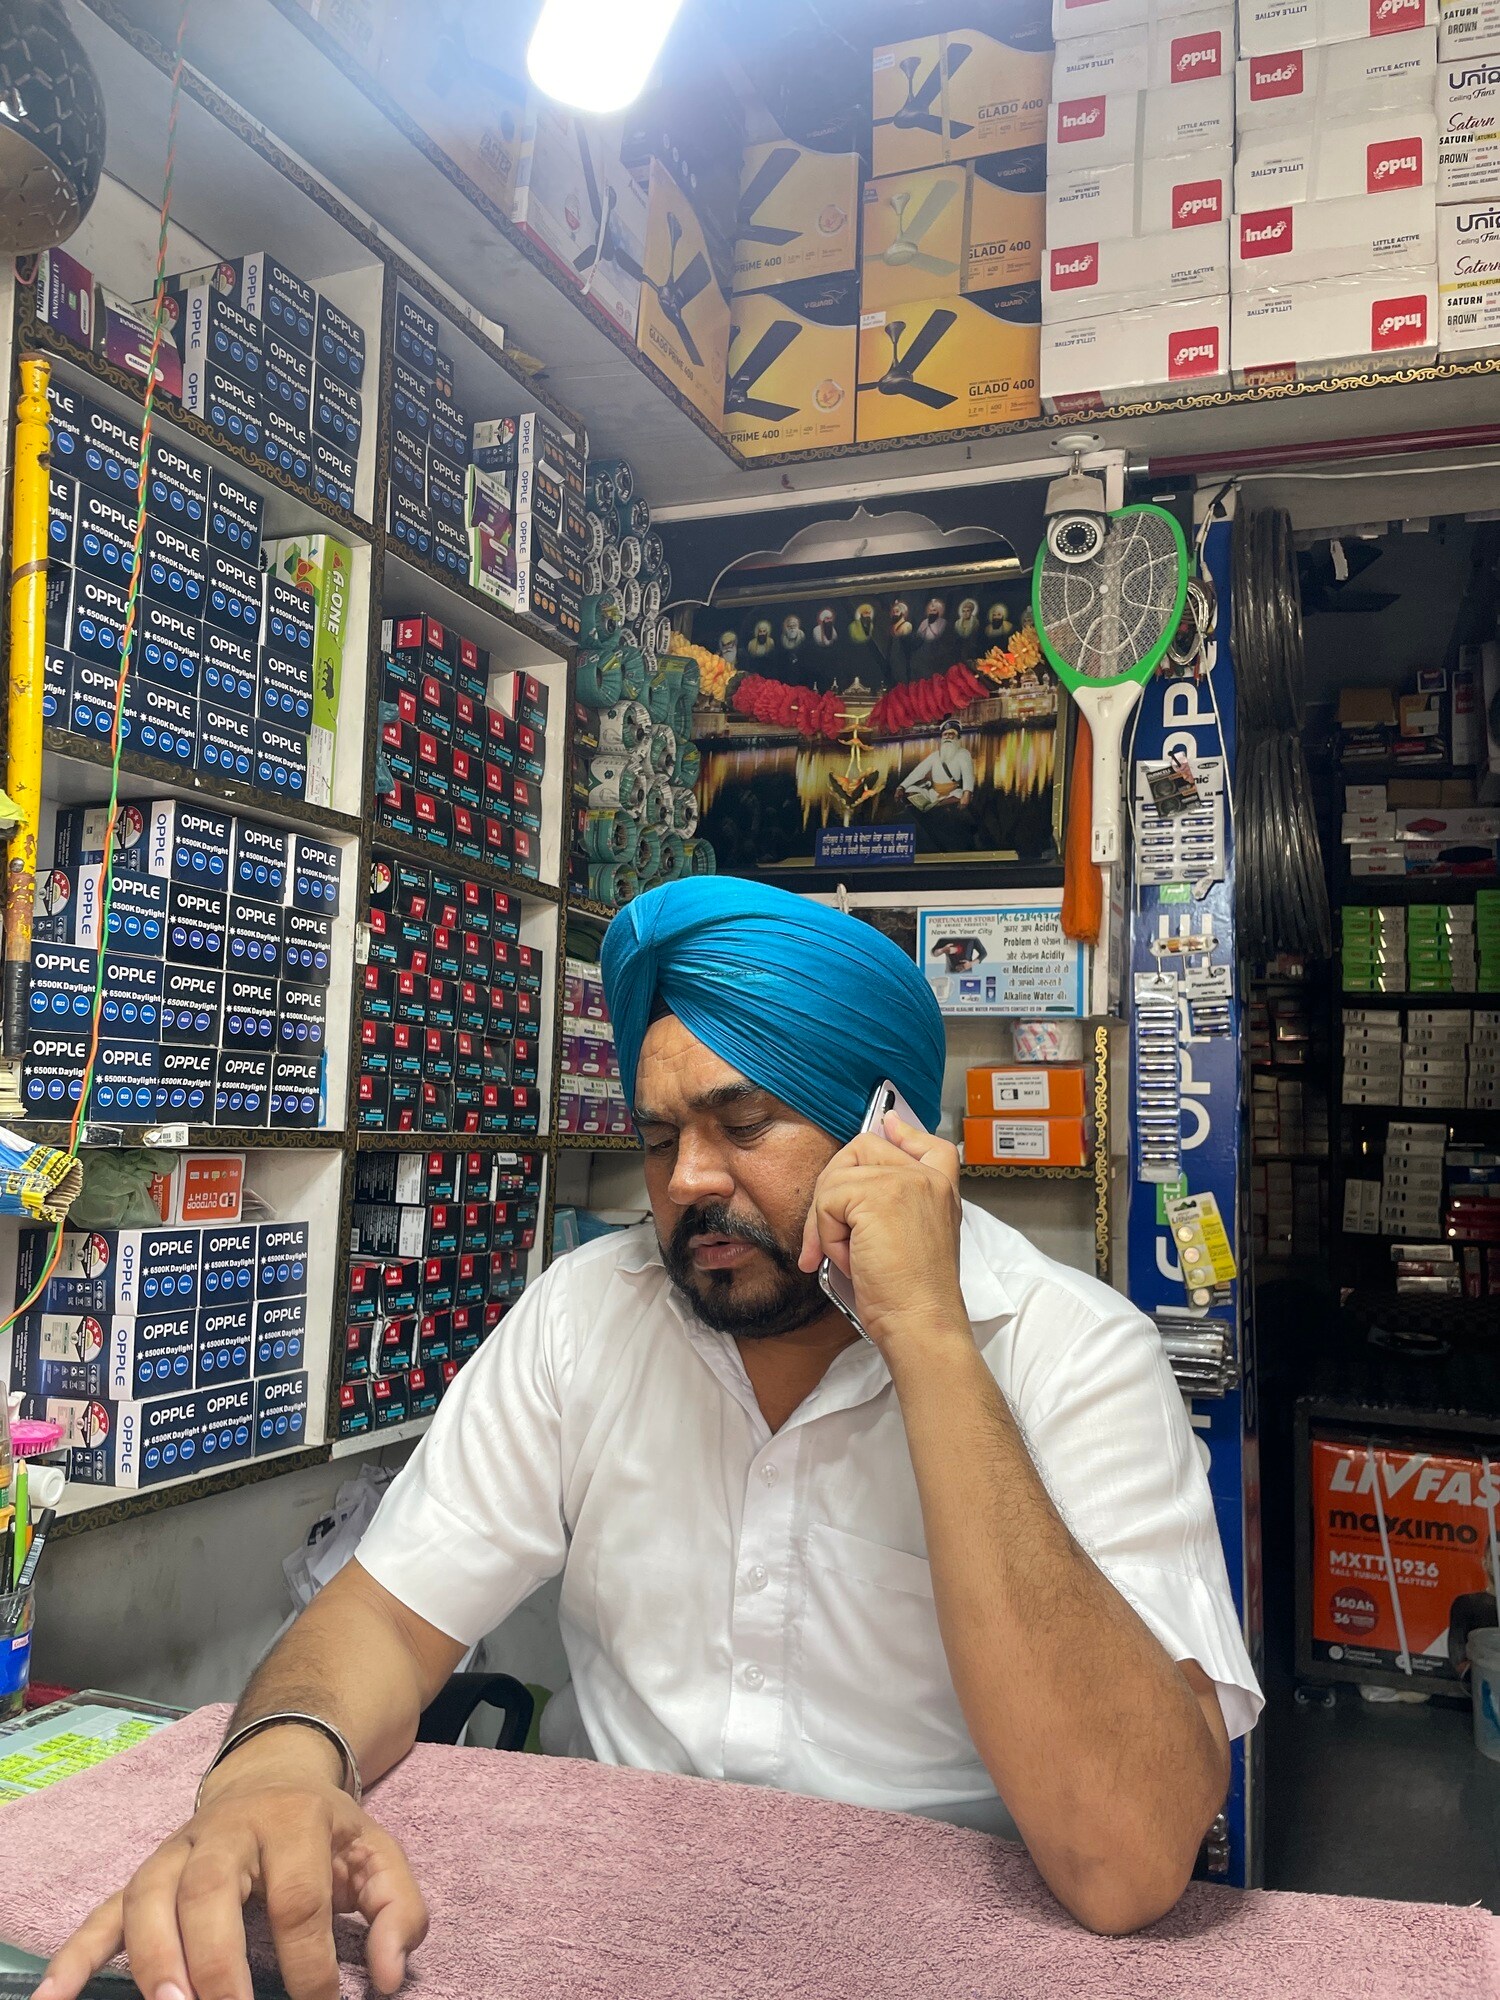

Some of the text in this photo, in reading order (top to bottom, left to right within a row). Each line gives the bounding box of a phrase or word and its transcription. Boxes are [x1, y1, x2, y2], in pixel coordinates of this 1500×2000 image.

[1255, 6, 1307, 20] LITTLE ACTIVE
[1444, 7, 1478, 20] SATURN
[1448, 21, 1478, 35] BROWN
[1183, 49, 1216, 67] Indo
[1366, 60, 1420, 74] LITTLE ACTIVE
[1255, 69, 1291, 85] Indo
[1449, 88, 1495, 102] Ceiling Fans
[978, 98, 1043, 119] GLADO 400
[1063, 114, 1095, 128] Indo
[1447, 113, 1495, 132] Saturn
[1439, 134, 1474, 145] SATURN
[1379, 157, 1417, 173] Indo
[1439, 153, 1468, 164] BROWN
[1251, 164, 1304, 177] LITTLE ACTIVE
[1183, 197, 1216, 214] Indo
[1245, 226, 1282, 242] Indo
[1457, 237, 1479, 245] Ceiling
[1009, 241, 1030, 252] 400
[734, 256, 782, 272] PRIME 400
[1055, 260, 1087, 275] Indo
[273, 267, 310, 303] OPPLE
[1448, 296, 1482, 306] SATURN
[218, 301, 257, 337] OPPLE
[326, 308, 360, 342] OPPLE
[404, 305, 434, 335] OPPLE
[1385, 314, 1421, 330] Indo
[1447, 314, 1477, 326] BROWN
[1179, 345, 1213, 361] Indo
[214, 375, 256, 408] OPPLE
[323, 377, 357, 409] OPPLE
[969, 379, 1034, 396] GLADO 400
[46, 387, 74, 413] PLE
[91, 414, 139, 451] OPPLE
[731, 430, 779, 443] PRIME 400
[158, 448, 202, 483] OPPLE
[432, 459, 461, 486] OPPLE
[219, 482, 257, 515] OPPLE
[437, 520, 466, 545] OPPLE
[156, 530, 200, 562] OPPLE
[216, 559, 256, 589] OPPLE
[274, 587, 310, 614] OPPLE
[328, 570, 344, 636] A-ONE
[151, 609, 195, 640] OPPLE
[210, 635, 252, 662] OPPLE
[147, 692, 191, 719] OPPLE
[262, 730, 301, 754] OPPLE
[181, 814, 224, 837] OPPLE
[302, 846, 337, 867] OPPLE
[112, 876, 160, 900] OPPLE
[82, 878, 94, 935] OPPLE
[177, 893, 220, 915] OPPLE
[978, 928, 993, 936] City
[1034, 923, 1058, 933] Acidity
[1004, 938, 1031, 946] Problem
[35, 954, 90, 974] OPPLE
[1040, 951, 1065, 960] Acidity
[1012, 965, 1043, 973] Medicine
[37, 980, 96, 994] 6500K Daylight
[171, 976, 216, 994] OPPLE
[1191, 980, 1226, 989] Panasonic
[1004, 992, 1054, 1000] Alkaline Water
[103, 1049, 152, 1067] OPPLE
[278, 1064, 316, 1079] OPPLE
[188, 1192, 218, 1201] LIGHT
[187, 1201, 217, 1210] OUTDOOR
[266, 1231, 303, 1247] OPPLE
[149, 1240, 193, 1257] OPPLE
[121, 1245, 133, 1301] OPPLE
[205, 1313, 246, 1331] OPPLE
[150, 1403, 195, 1426] OPPLE
[121, 1415, 133, 1473] OPPLE
